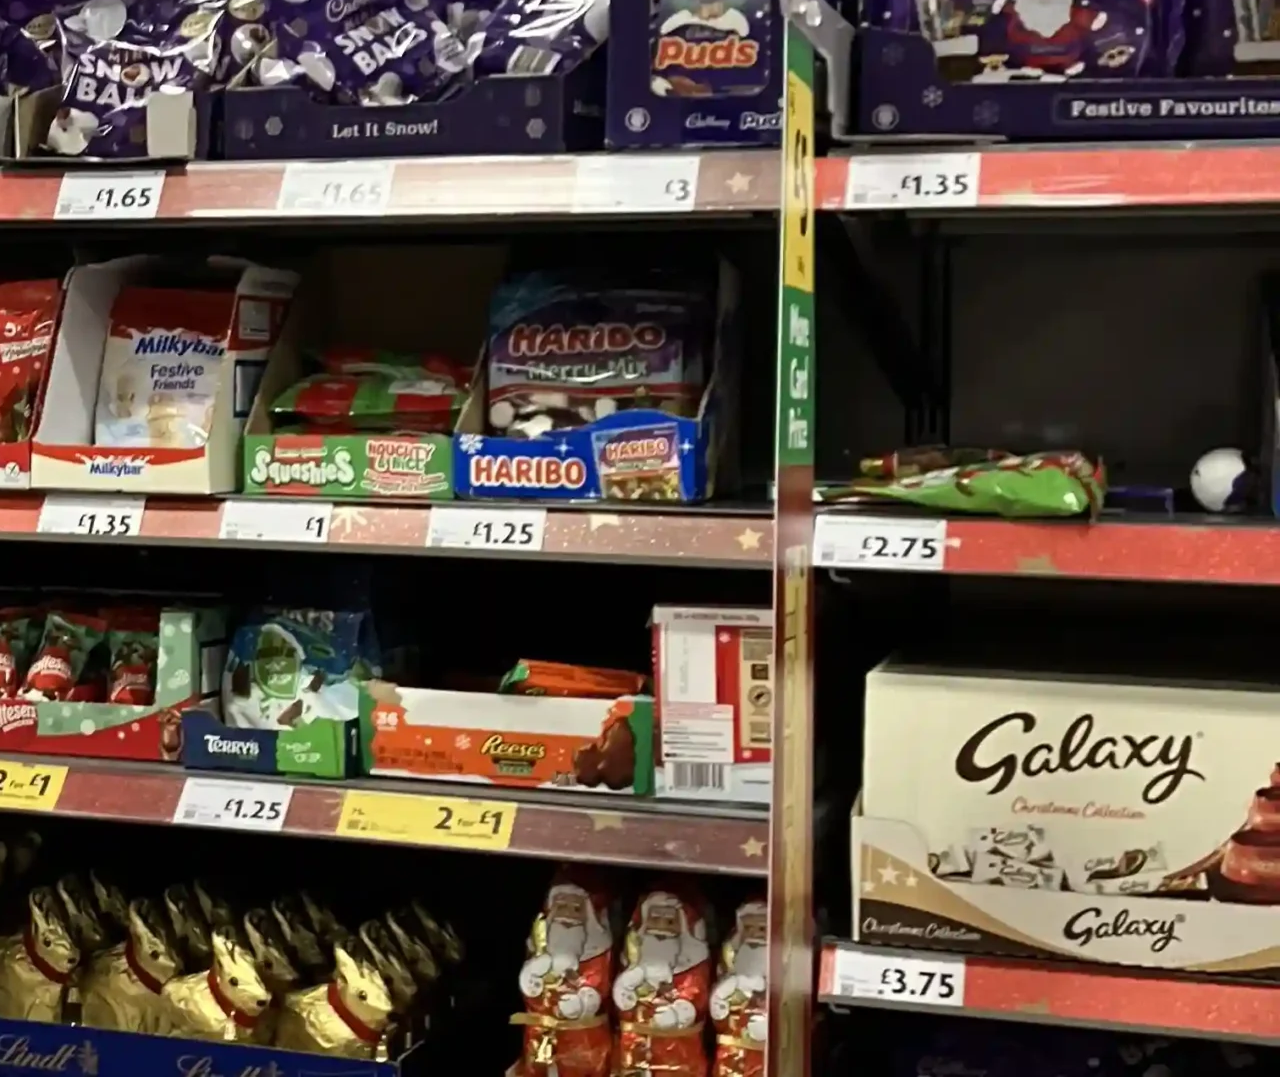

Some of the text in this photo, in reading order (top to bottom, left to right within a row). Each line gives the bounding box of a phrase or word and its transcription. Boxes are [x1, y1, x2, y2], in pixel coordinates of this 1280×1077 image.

[655, 36, 760, 70] Puds
[739, 111, 784, 129] Pud
[1071, 100, 1153, 118] Festive
[332, 120, 439, 139] Let It Snow!
[323, 183, 382, 207] £1.65
[665, 179, 690, 201] £3
[901, 174, 969, 197] £1.35
[96, 188, 152, 209] £1.65
[135, 332, 225, 358] Milkybar
[508, 322, 666, 357] HARIBO
[150, 363, 204, 379] Festive
[152, 377, 196, 392] Friends
[605, 437, 669, 460] HARIBO
[90, 460, 144, 477] Milkybar
[470, 455, 587, 488] HARIBO
[79, 513, 132, 535] £1.35
[306, 516, 325, 537] £1
[473, 522, 533, 544] £1.25
[863, 535, 938, 559] £2.75
[479, 733, 546, 759] Reese's
[954, 711, 1206, 805] Galaxy
[9, 779, 26, 791] for
[29, 771, 53, 797] £1
[223, 798, 282, 821] £1.25
[1011, 795, 1147, 820] Christmas Collection
[433, 806, 504, 836] 2 for £1
[862, 916, 982, 942] Christmas Collection
[1062, 906, 1182, 953] Galaxy
[880, 968, 955, 998] £3.75
